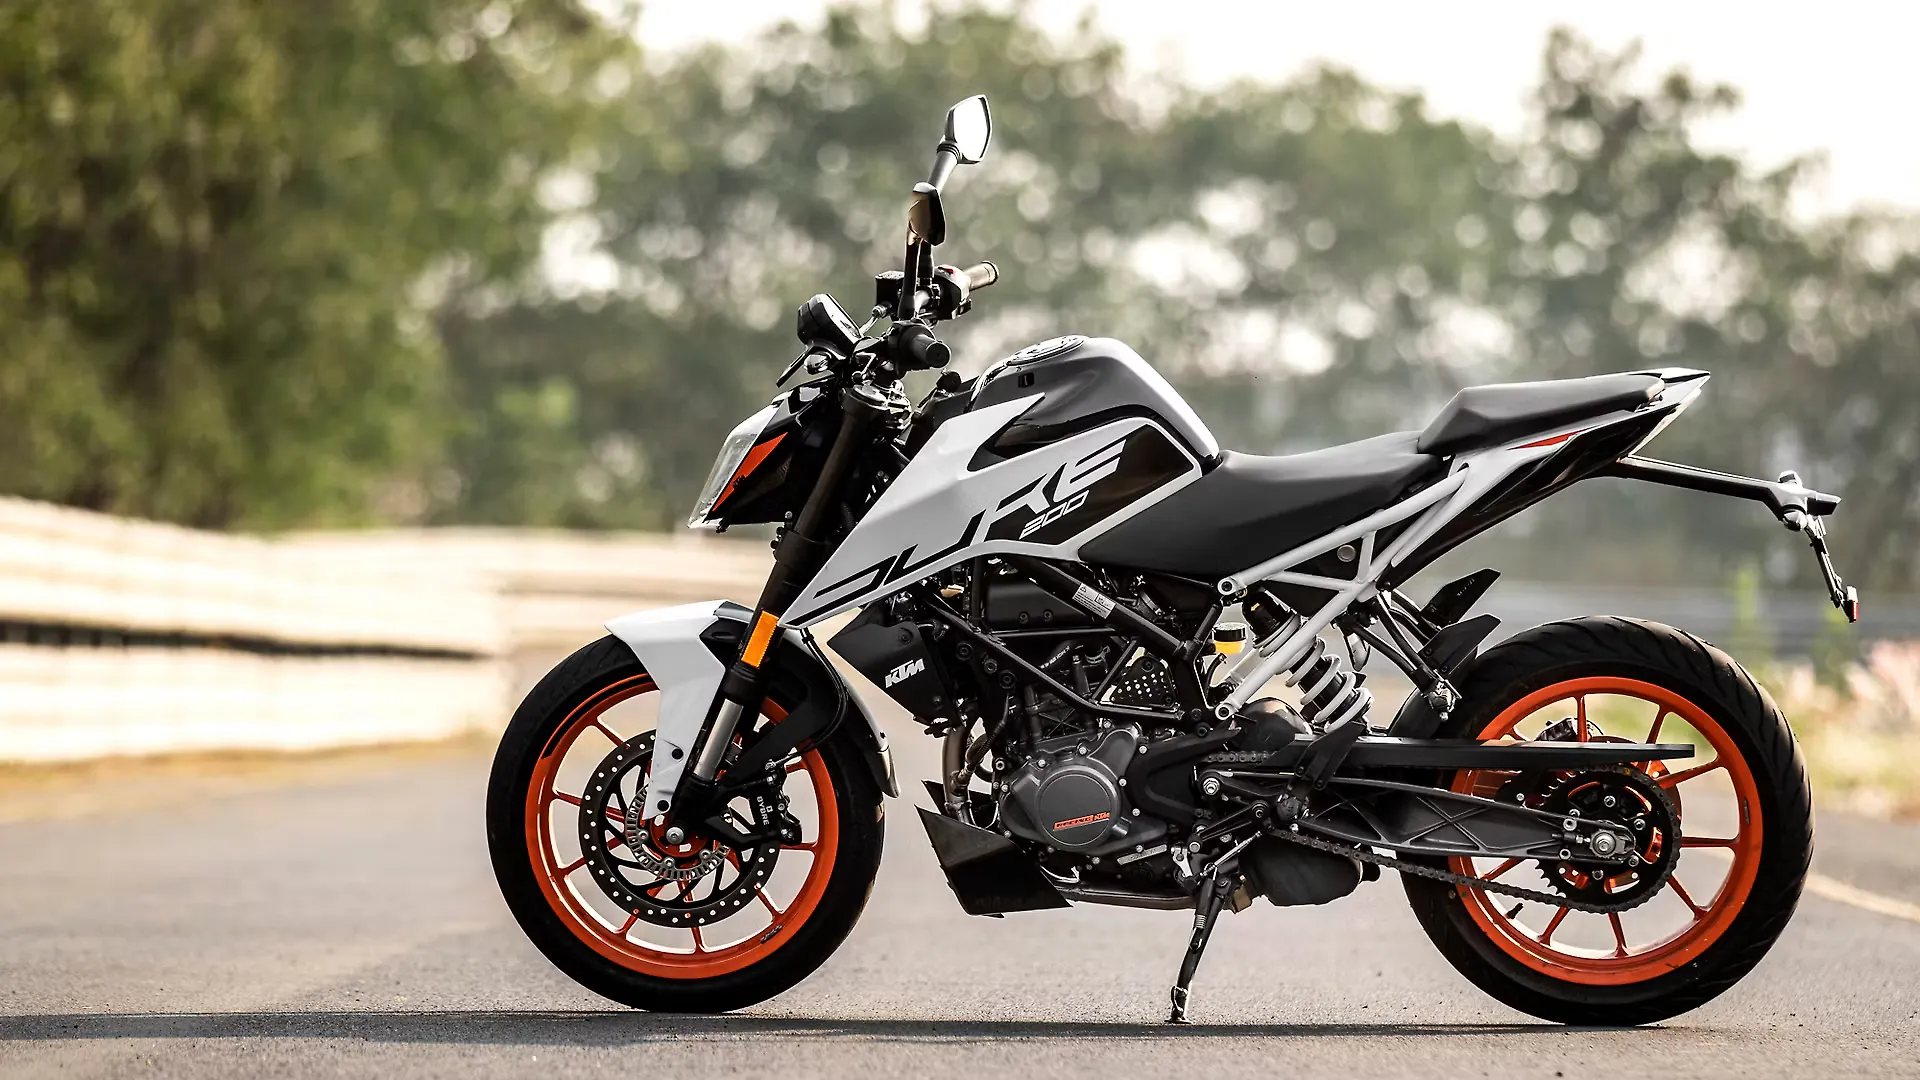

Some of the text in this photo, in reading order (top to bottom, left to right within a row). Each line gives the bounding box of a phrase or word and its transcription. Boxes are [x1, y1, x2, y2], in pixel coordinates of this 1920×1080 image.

[785, 439, 1126, 626] DUKE
[1019, 490, 1090, 540] 200
[885, 658, 925, 689] KTM
